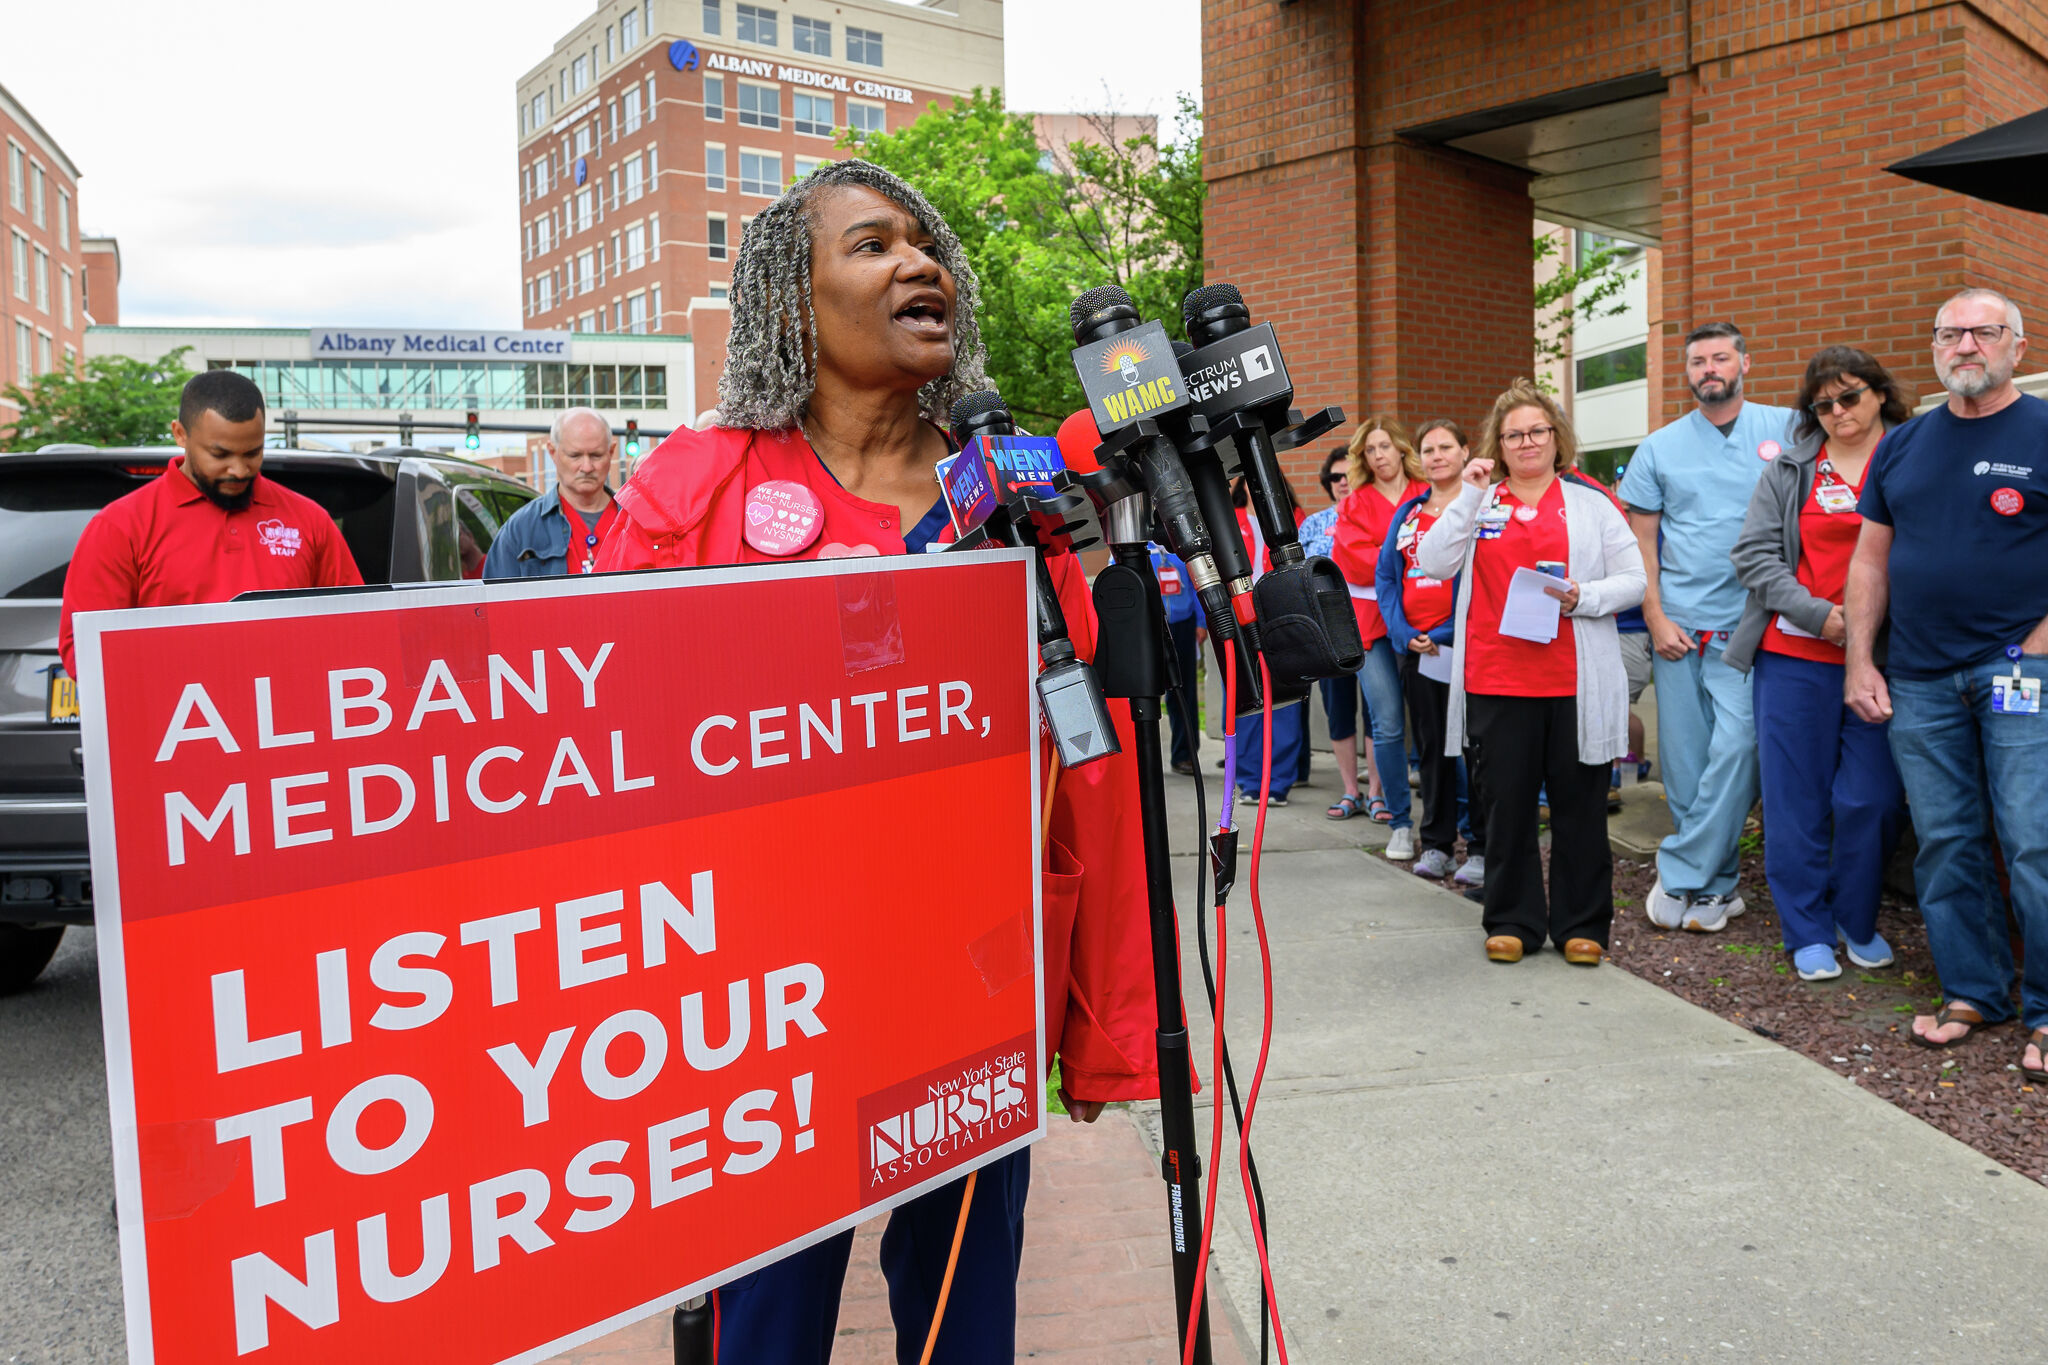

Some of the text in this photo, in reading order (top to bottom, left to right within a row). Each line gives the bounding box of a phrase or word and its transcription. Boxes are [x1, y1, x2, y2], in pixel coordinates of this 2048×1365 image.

[707, 53, 913, 104] ALBANY MEDICAL CENTER
[320, 333, 564, 356] Albany Medical Center
[1184, 357, 1237, 388] ECTRUM
[1189, 370, 1242, 403] NEWS
[1102, 376, 1176, 423] WAMC
[950, 456, 980, 509] WENY
[990, 449, 1053, 471] WENY
[753, 493, 820, 518] AMC NURSES.
[757, 486, 792, 500] WE ARE
[964, 480, 984, 511] NEWS
[763, 526, 805, 546] NYSNA.
[771, 520, 806, 537] WE ARE
[154, 642, 615, 762] ALBANY
[164, 679, 992, 867] MEDICAL CENTER,
[211, 869, 717, 1074] LISTEN
[215, 962, 828, 1208] TO YOUR
[928, 1051, 1026, 1101] New York State
[870, 1063, 1027, 1170] NURSES
[871, 1103, 1029, 1188] ASSOCIATION
[231, 1071, 816, 1357] NURSES!
[1171, 1183, 1186, 1253] FRAMEWORKS
